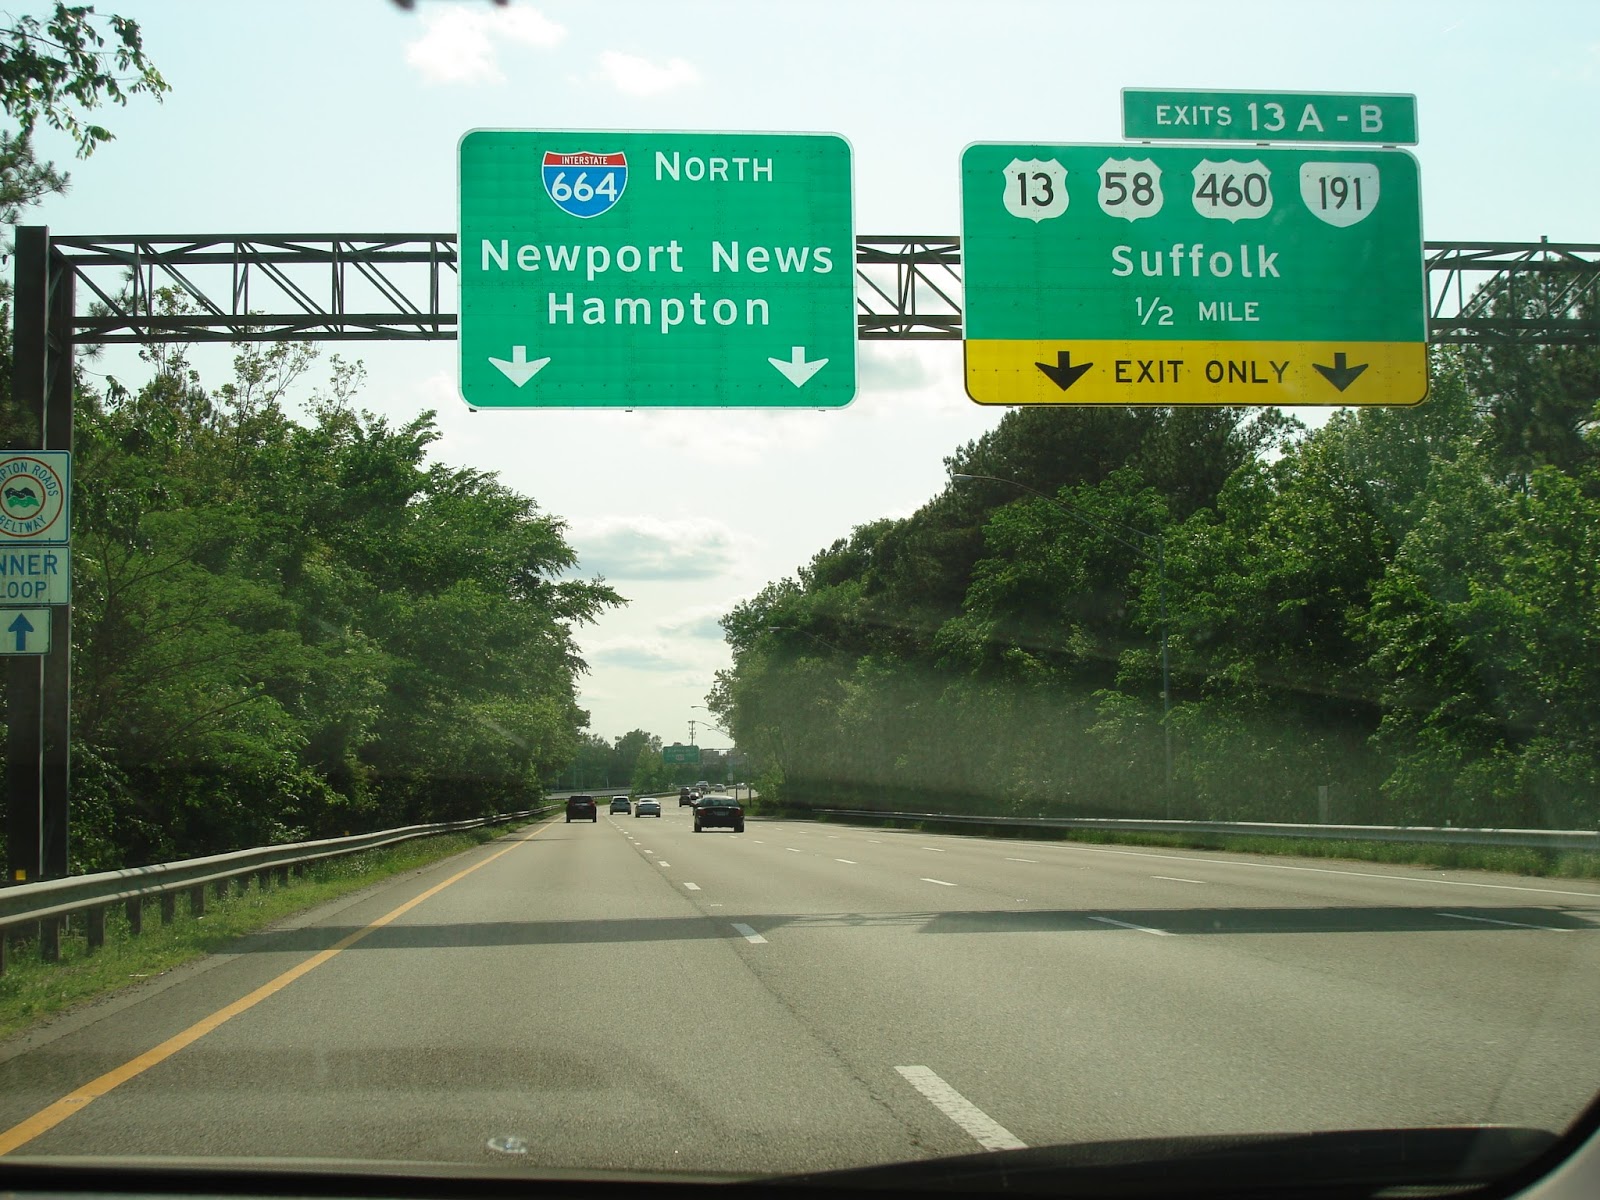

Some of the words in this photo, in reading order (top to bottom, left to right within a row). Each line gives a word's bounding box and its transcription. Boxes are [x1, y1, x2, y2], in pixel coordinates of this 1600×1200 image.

[1156, 104, 1232, 126] EXITS
[1247, 102, 1286, 132] 13
[561, 155, 608, 166] INTERSTATE
[655, 151, 773, 182] NORTH
[551, 171, 618, 202] 664
[1017, 172, 1054, 207] 13
[1105, 171, 1155, 207] 58
[1195, 172, 1267, 208] 460
[1318, 176, 1362, 211] 191
[481, 239, 684, 282] Newport
[712, 240, 834, 273] News
[1111, 244, 1281, 278] Suffolk
[548, 292, 770, 334] Hampton
[1135, 296, 1174, 326] 1/2
[1198, 301, 1260, 322] MILE
[1115, 360, 1184, 383] EXIT
[1205, 360, 1290, 384] ONLY
[32, 465, 59, 497] ROADS
